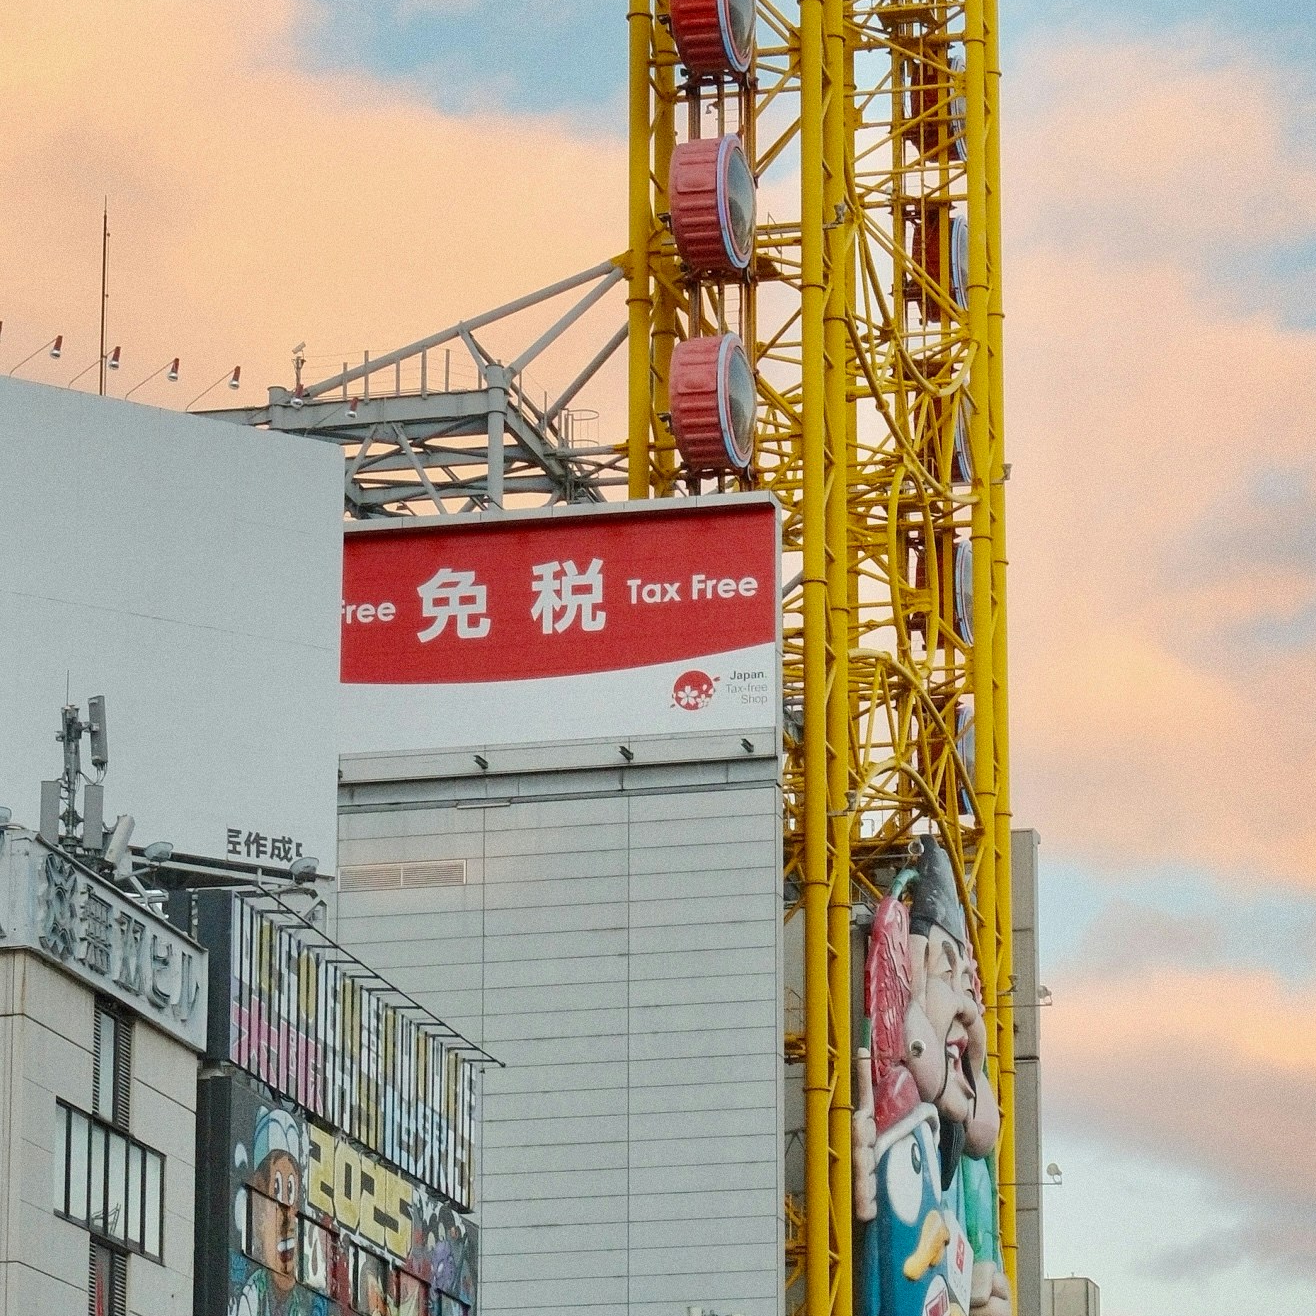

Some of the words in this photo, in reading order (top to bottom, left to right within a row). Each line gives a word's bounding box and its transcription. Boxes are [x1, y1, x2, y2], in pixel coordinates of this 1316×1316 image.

[627, 577, 682, 606] Tax
[691, 574, 759, 601] Free
[726, 684, 768, 694] Tax-free
[741, 694, 768, 705] Shop
[307, 1125, 413, 1263] 2025
